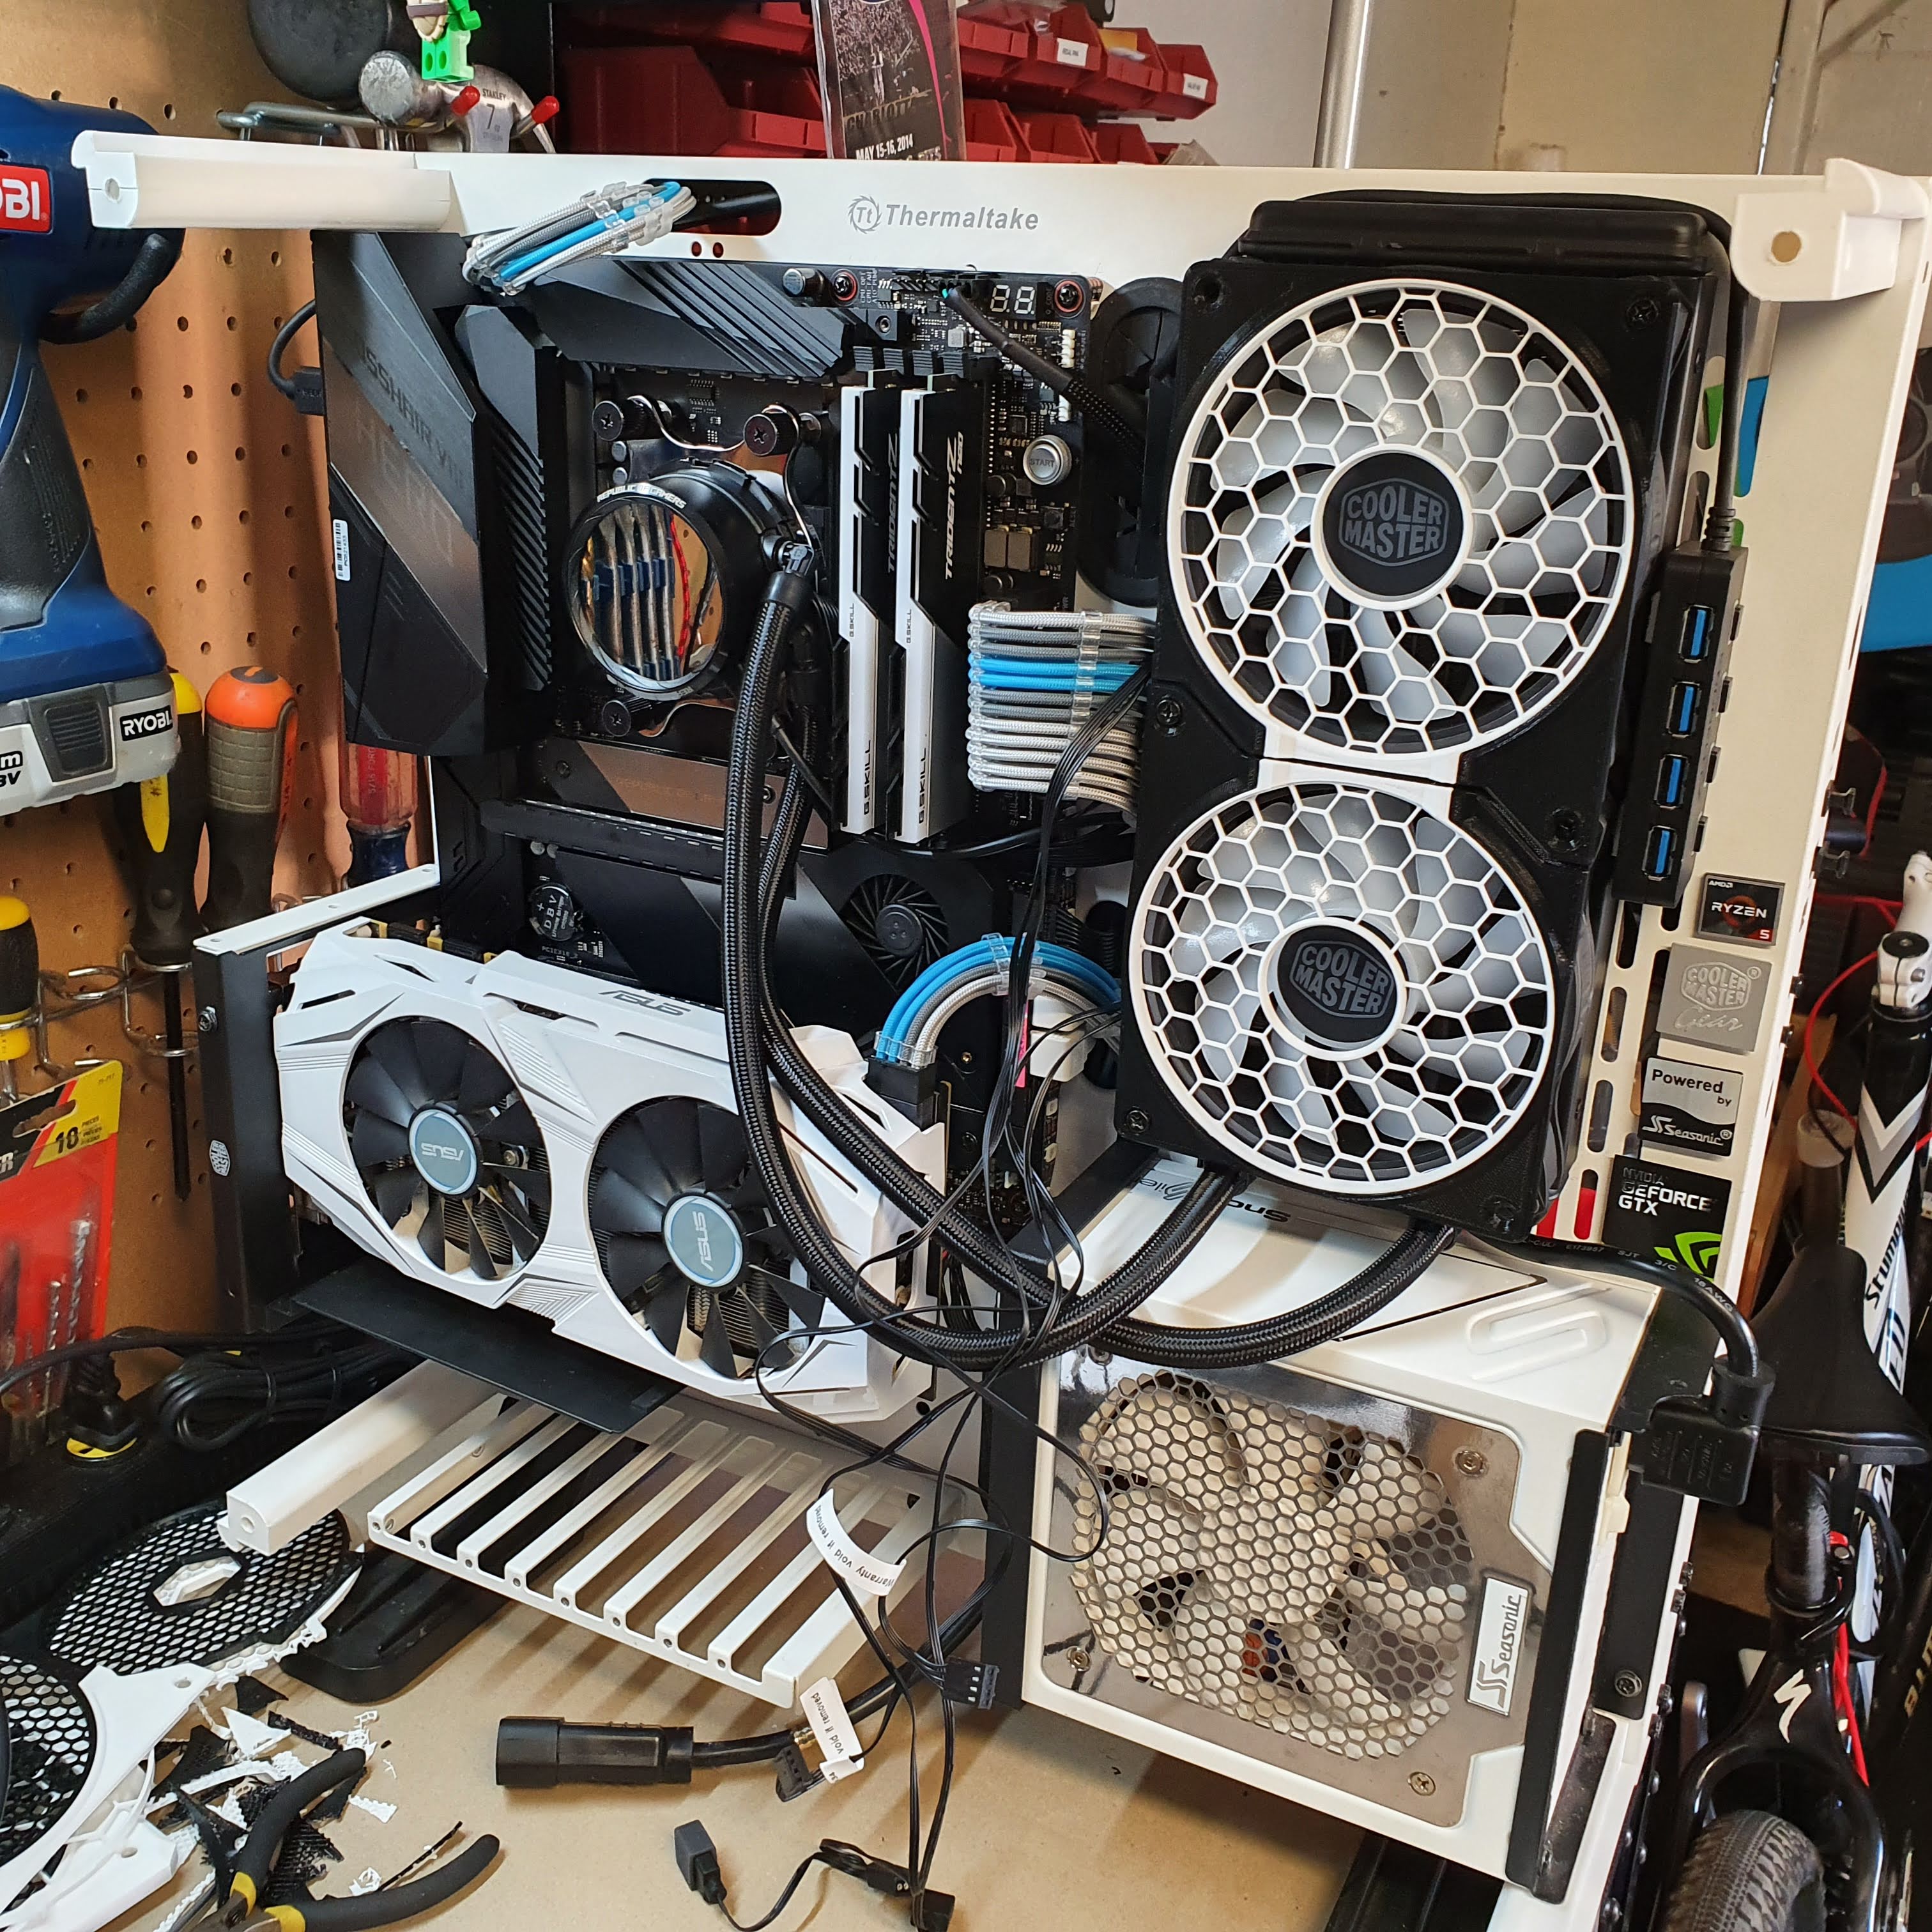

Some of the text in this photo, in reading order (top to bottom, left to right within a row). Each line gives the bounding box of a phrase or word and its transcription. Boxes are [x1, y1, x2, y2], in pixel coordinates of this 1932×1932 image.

[482, 88, 506, 101] STANLEY
[855, 145, 876, 160] MAY
[876, 138, 896, 158] 15-16,
[897, 134, 914, 151] 2014
[0, 178, 40, 220] BI
[886, 204, 1039, 230] Thermaltake
[1029, 459, 1055, 468] START
[597, 485, 636, 503] REPUBLIC
[650, 486, 687, 509] GAMERS
[1347, 486, 1443, 525] COOLER
[1345, 520, 1440, 558] MASTER
[122, 710, 170, 736] RYOBI
[1712, 901, 1767, 918] RYZEN
[1302, 946, 1388, 995] COOLER
[1687, 967, 1747, 992] COOLER
[1295, 964, 1382, 1013] MASTER
[1685, 981, 1745, 1006] MASTER
[599, 989, 691, 1016] ASUS
[1652, 1069, 1724, 1093] Powered
[1717, 1096, 1732, 1107] by
[56, 1126, 79, 1154] 10
[1664, 1124, 1724, 1146] Seasonic
[421, 1142, 464, 1162] ASUS
[1618, 1194, 1659, 1216] GTX
[1621, 1181, 1713, 1212] GEFORCE
[1226, 1199, 1291, 1223] Sno
[692, 1209, 714, 1272] ASUS
[1617, 1250, 1640, 1259] SJT
[1655, 1259, 1677, 1271] 3/C
[1865, 1208, 1906, 1310] Stump
[834, 1549, 853, 1568] void
[856, 1565, 894, 1587] Warranty
[1491, 1594, 1522, 1678] Seasonic
[811, 1692, 844, 1754] void if removed
